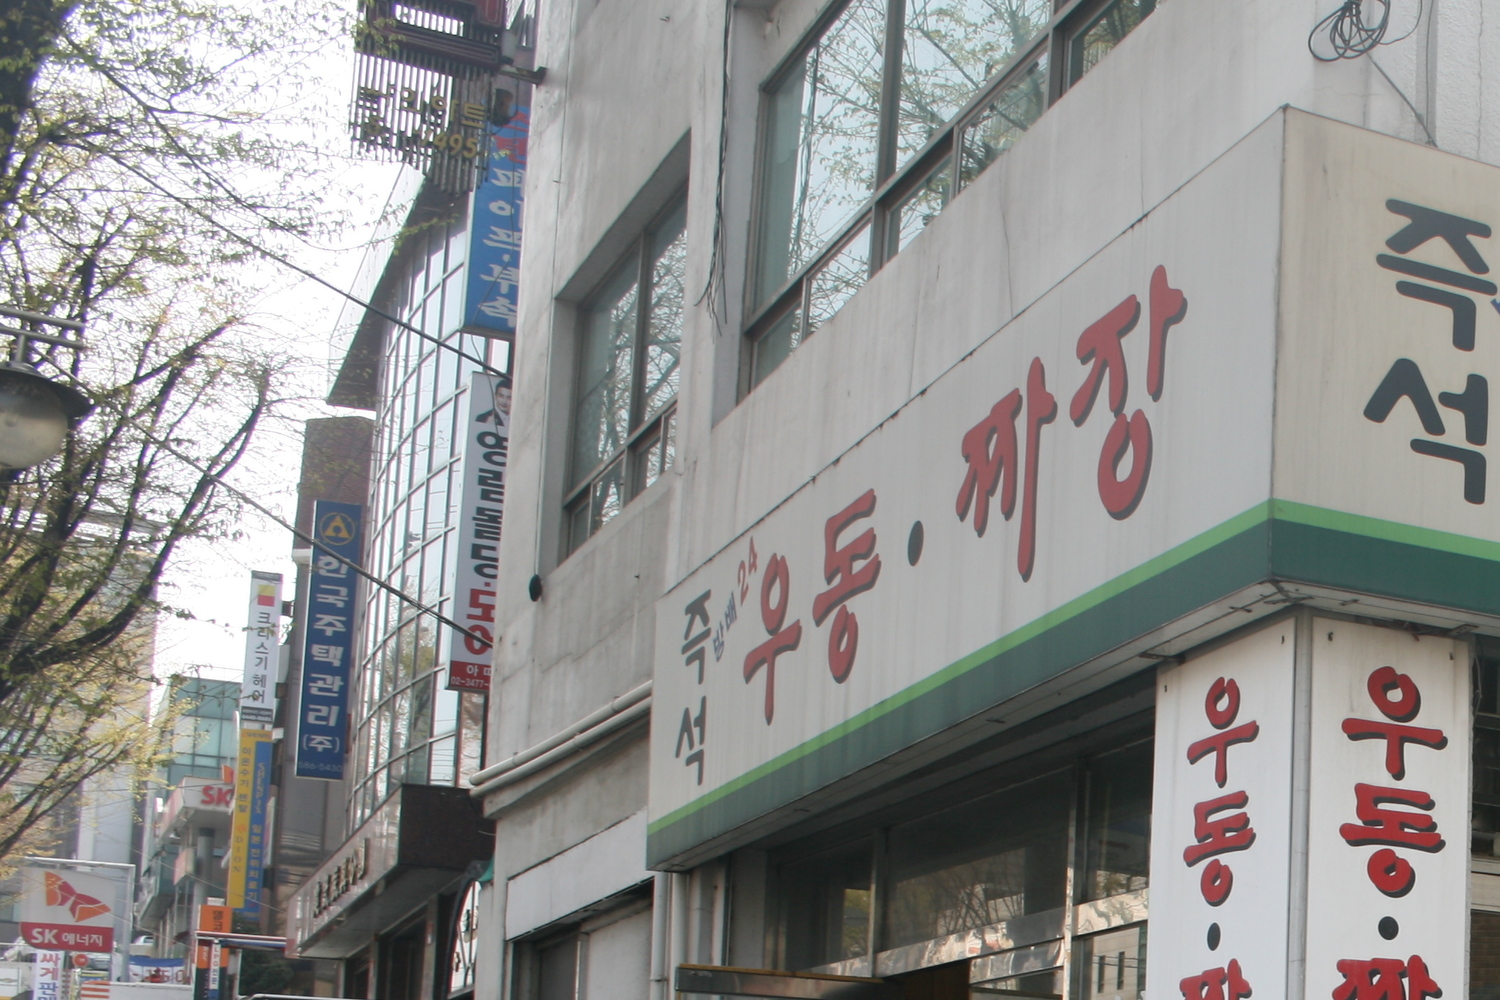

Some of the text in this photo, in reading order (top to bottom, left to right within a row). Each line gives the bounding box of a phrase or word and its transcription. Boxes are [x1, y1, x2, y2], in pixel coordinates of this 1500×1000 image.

[201, 785, 234, 808] SK
[31, 928, 103, 947] SK 에너지
